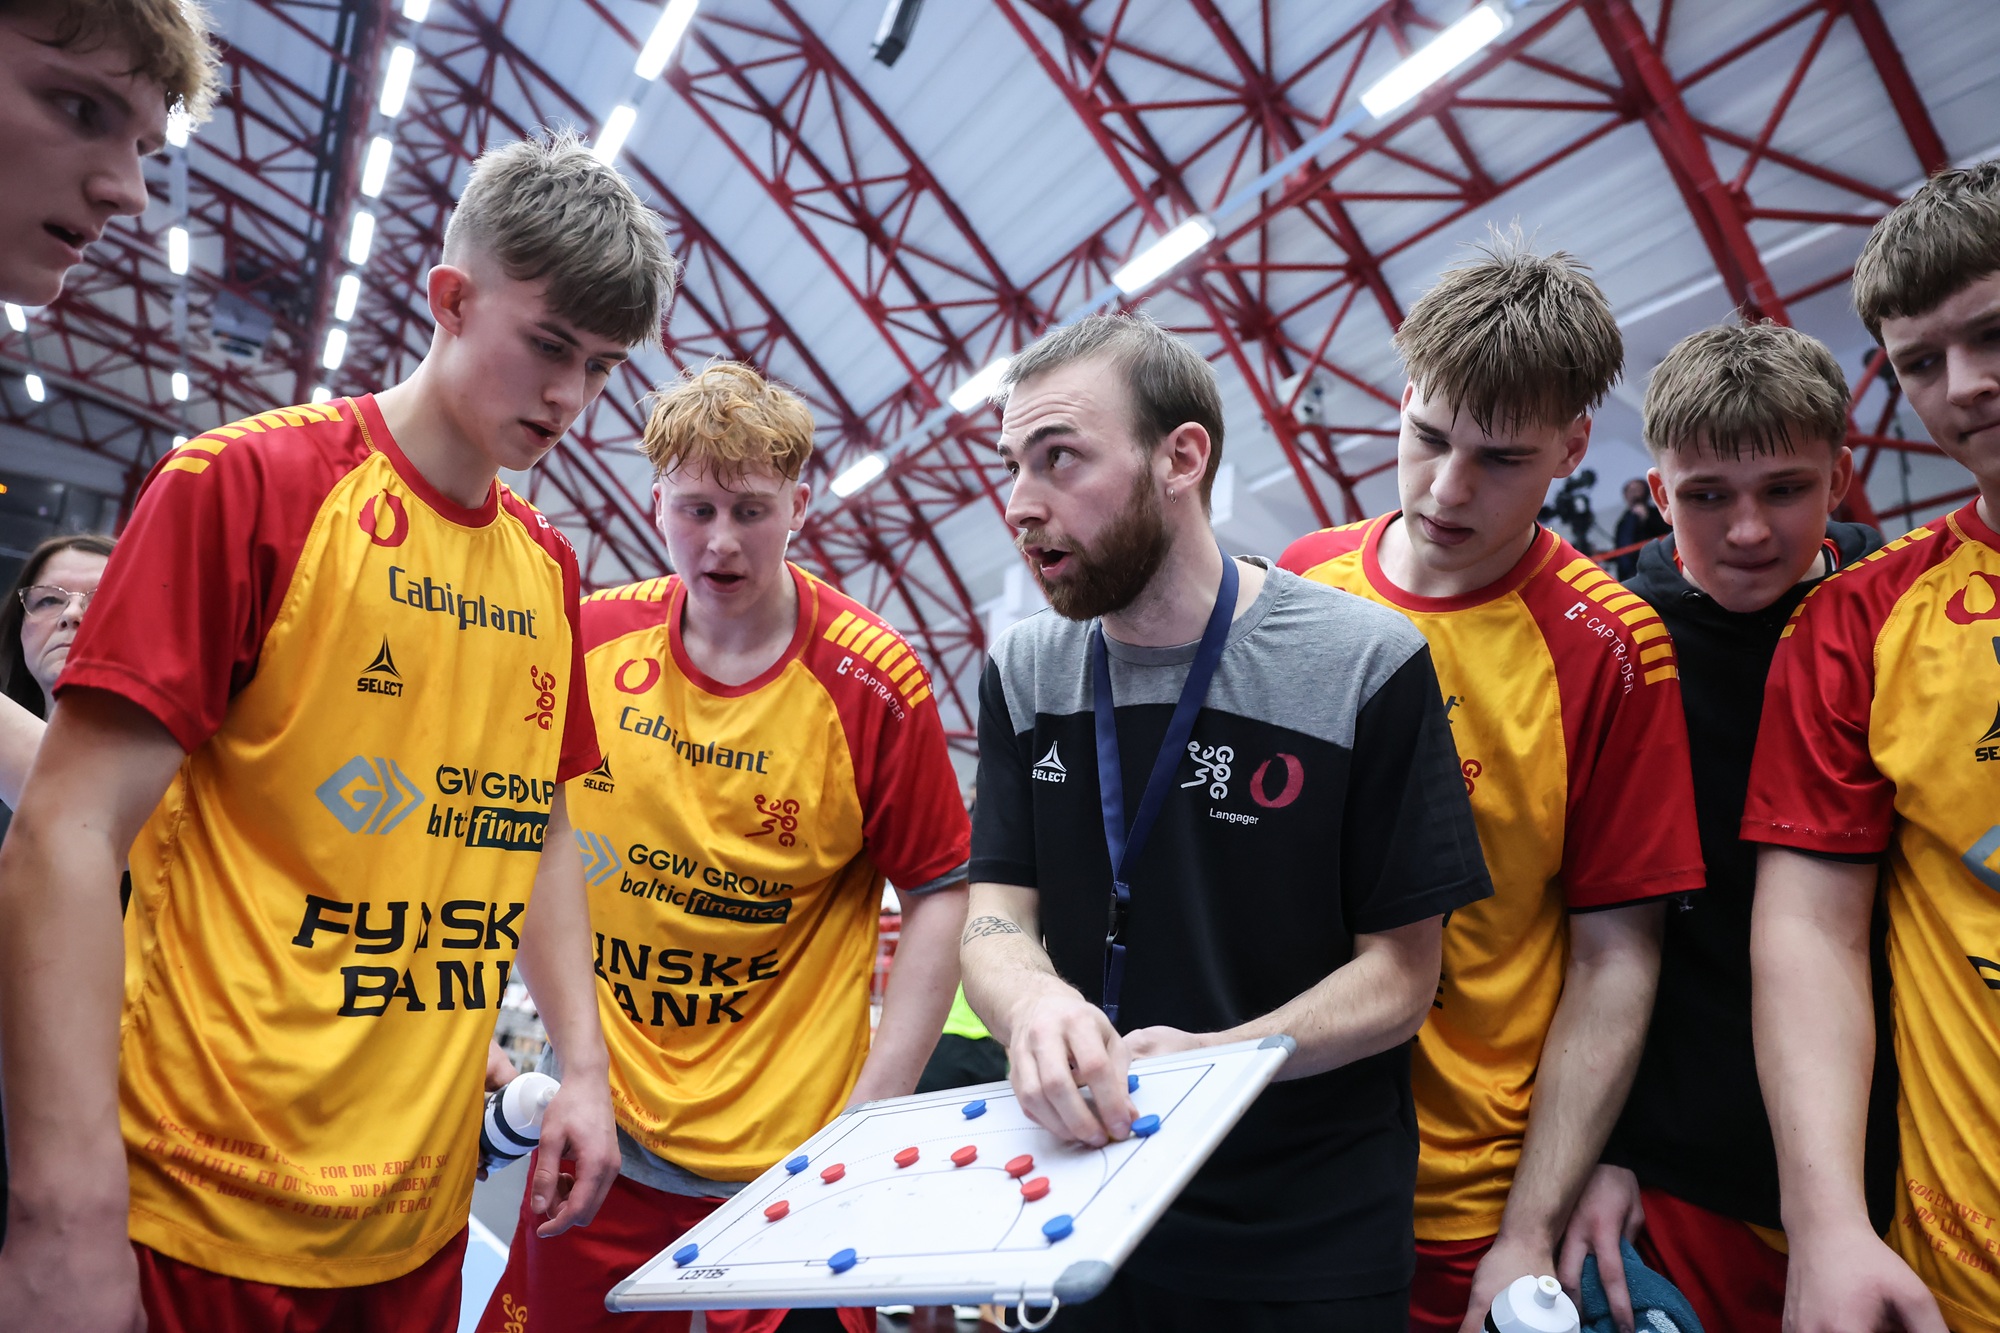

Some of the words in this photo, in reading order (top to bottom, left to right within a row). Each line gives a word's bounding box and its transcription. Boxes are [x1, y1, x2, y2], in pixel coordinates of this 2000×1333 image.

[1586, 617, 1635, 694] CAPTRADER
[357, 677, 403, 697] SELECT
[854, 668, 905, 722] CAPTRADER
[619, 706, 769, 774] Cabinplant
[583, 778, 615, 794] SELECT
[1032, 768, 1067, 783] SELECT
[1209, 807, 1260, 825] Langager
[628, 843, 698, 879] GGW
[620, 871, 687, 906] baltic
[689, 893, 787, 919] finance
[612, 982, 749, 1027] ANK
[320, 1165, 348, 1179] FOR
[352, 1163, 377, 1178] DIN
[421, 1156, 432, 1169] VI
[257, 1169, 278, 1188] ER
[282, 1174, 302, 1192] DU
[305, 1182, 338, 1197] STOR
[350, 1184, 368, 1198] DU
[1906, 1179, 1934, 1202] GOG
[311, 1204, 332, 1218] ER
[334, 1205, 359, 1220] FRA
